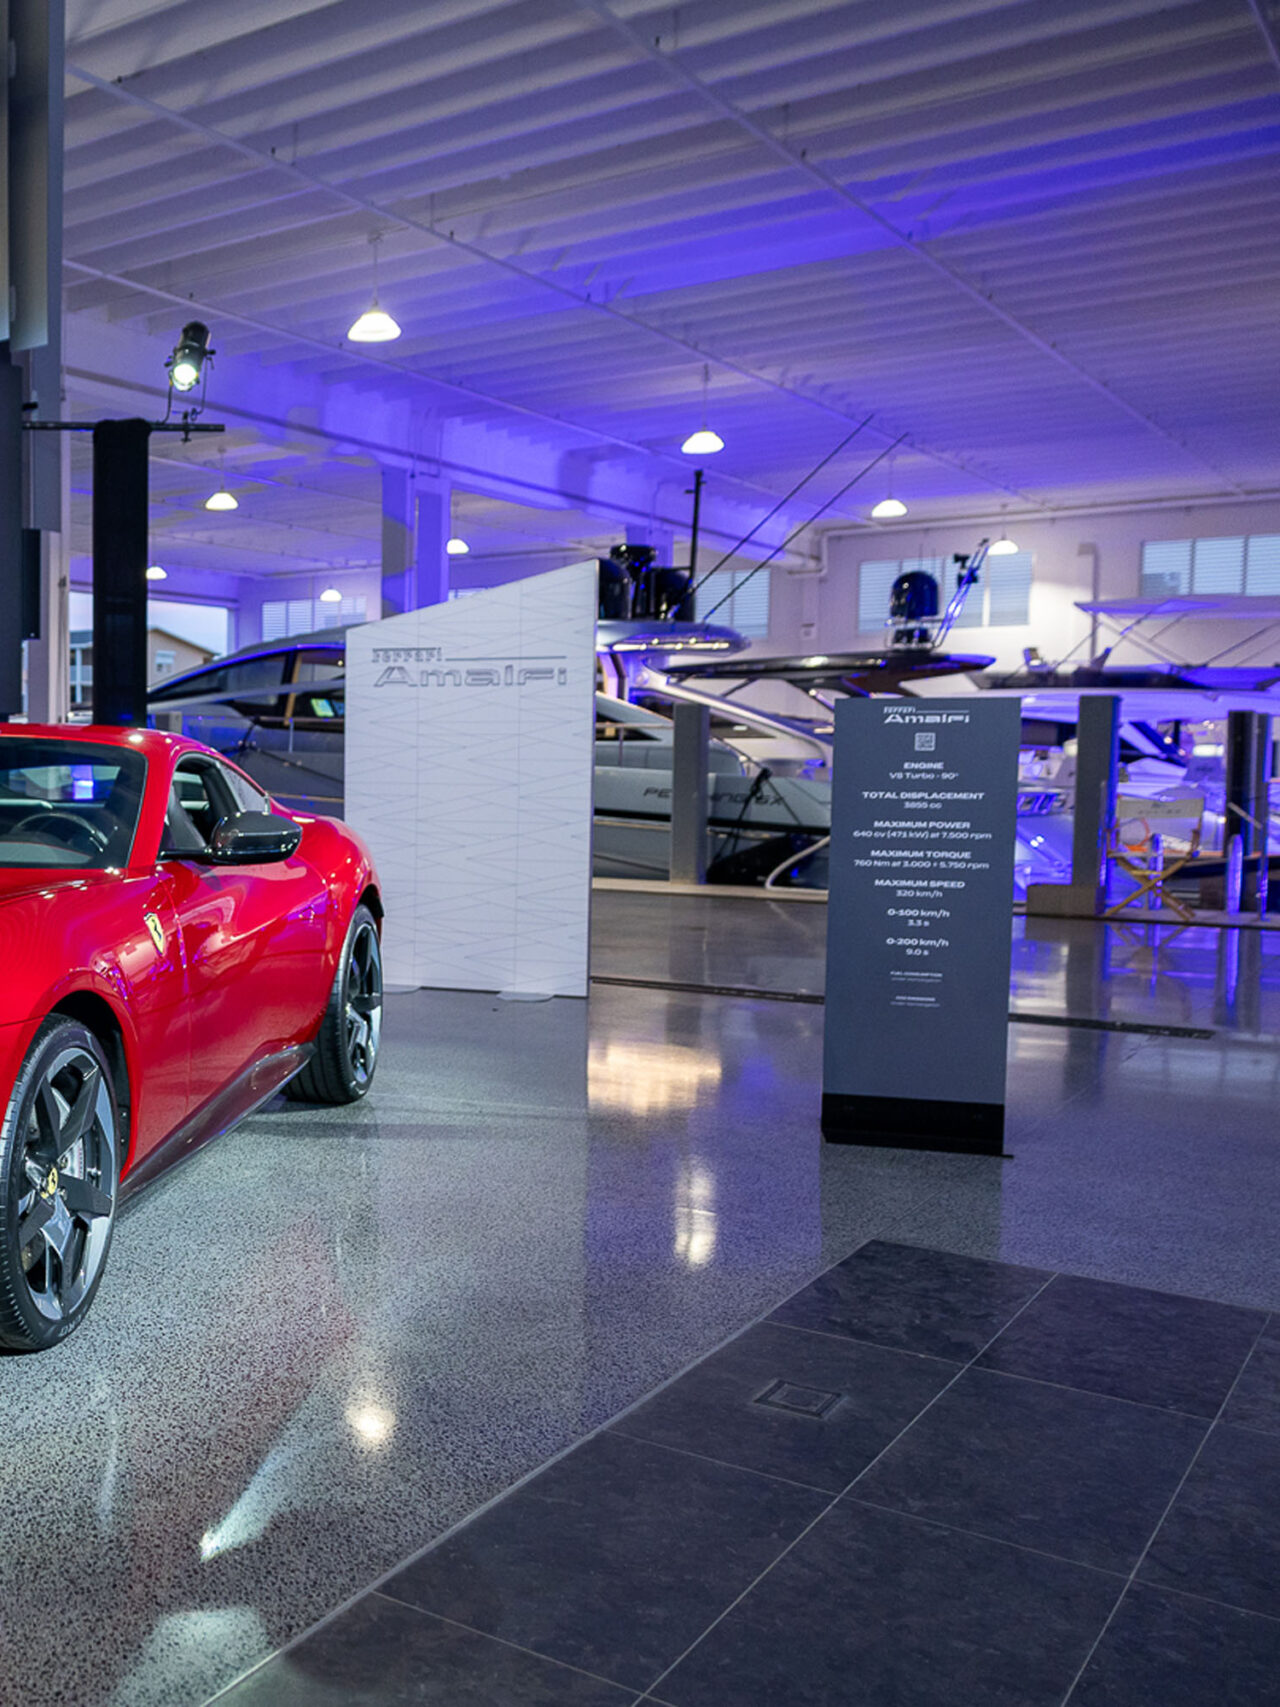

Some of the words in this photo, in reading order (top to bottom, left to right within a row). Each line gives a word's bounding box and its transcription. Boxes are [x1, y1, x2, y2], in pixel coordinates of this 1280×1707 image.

[862, 791, 898, 799] TOTAL
[900, 791, 985, 800] DISPLACEMENT
[873, 820, 927, 828] MAXIMUM
[928, 821, 971, 829] POWER
[853, 830, 873, 838] 640
[970, 832, 992, 840] rpm
[870, 849, 924, 858] MAXIMUM
[925, 850, 972, 859] TORQUE
[853, 859, 872, 867] 760
[967, 862, 990, 870] rpm
[874, 879, 928, 887] MAXIMUM
[929, 880, 965, 888] SPEED
[896, 889, 915, 897] 320
[916, 890, 943, 898] km/h
[887, 908, 919, 917] 0-100
[920, 909, 950, 918] km/h
[886, 937, 919, 946] 0-200
[919, 938, 949, 947] km/h
